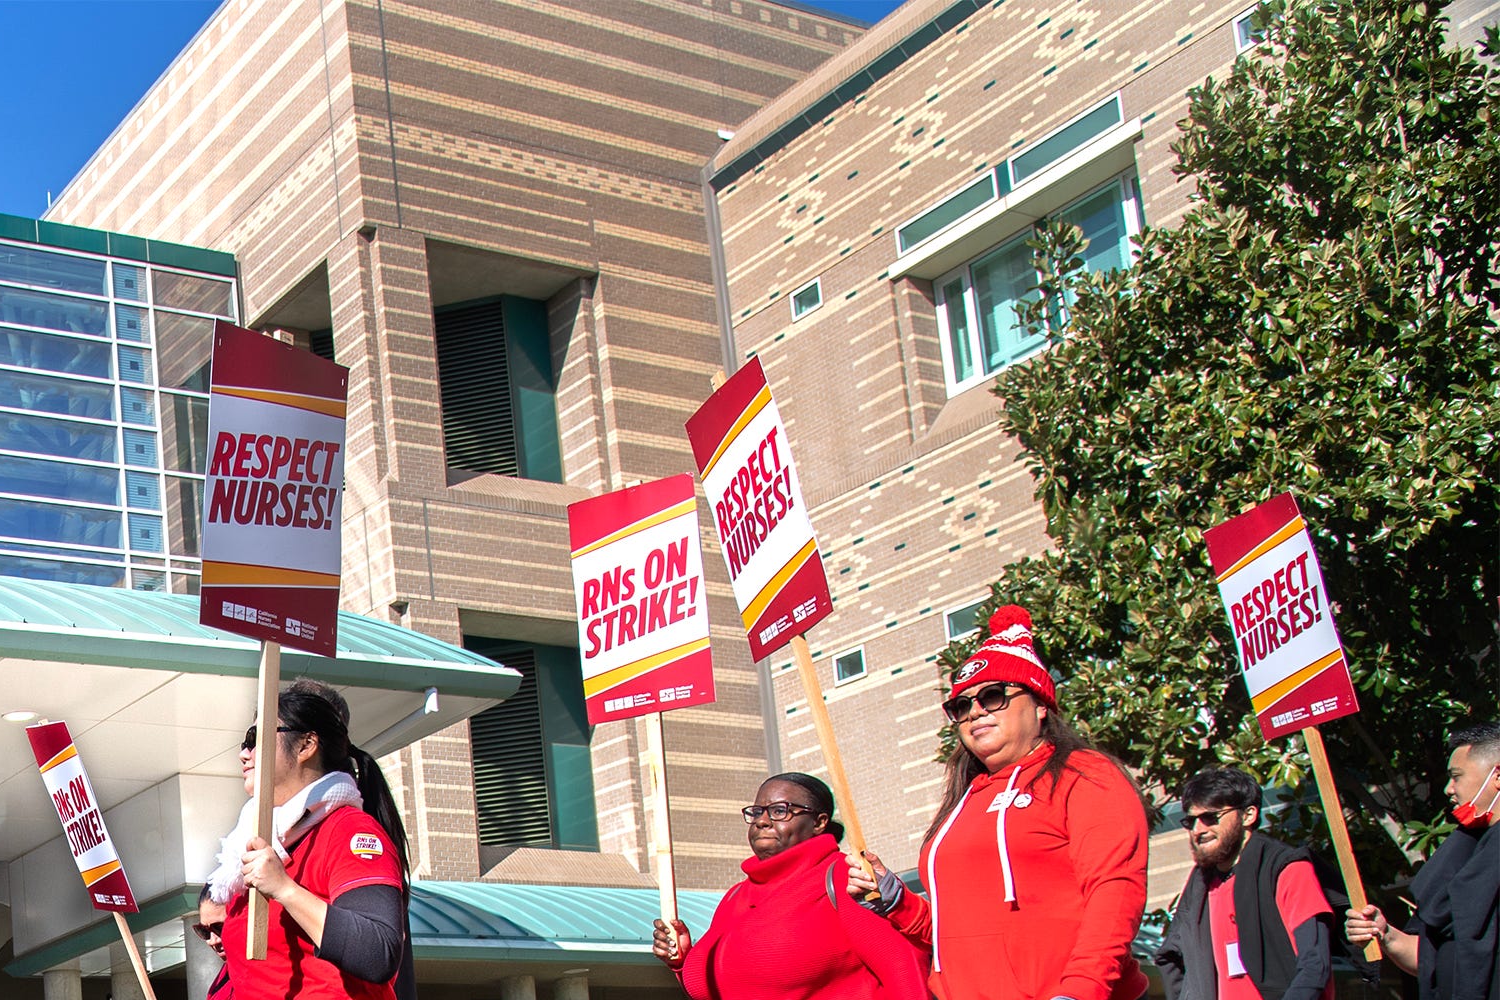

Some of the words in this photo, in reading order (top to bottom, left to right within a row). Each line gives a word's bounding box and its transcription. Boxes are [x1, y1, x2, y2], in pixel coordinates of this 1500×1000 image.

[209, 431, 341, 486] RESPECT
[716, 426, 782, 544] RESPECT
[208, 478, 337, 531] NURSES!
[726, 465, 794, 582] NURSES!
[581, 565, 636, 620] RNs
[643, 536, 689, 589] ON
[584, 575, 699, 660] STRIKE!
[1230, 551, 1309, 640] RESPECT
[1239, 584, 1322, 672] NURSES!
[53, 788, 75, 824] RNs
[68, 775, 91, 814] ON
[67, 808, 106, 858] STRIKE!
